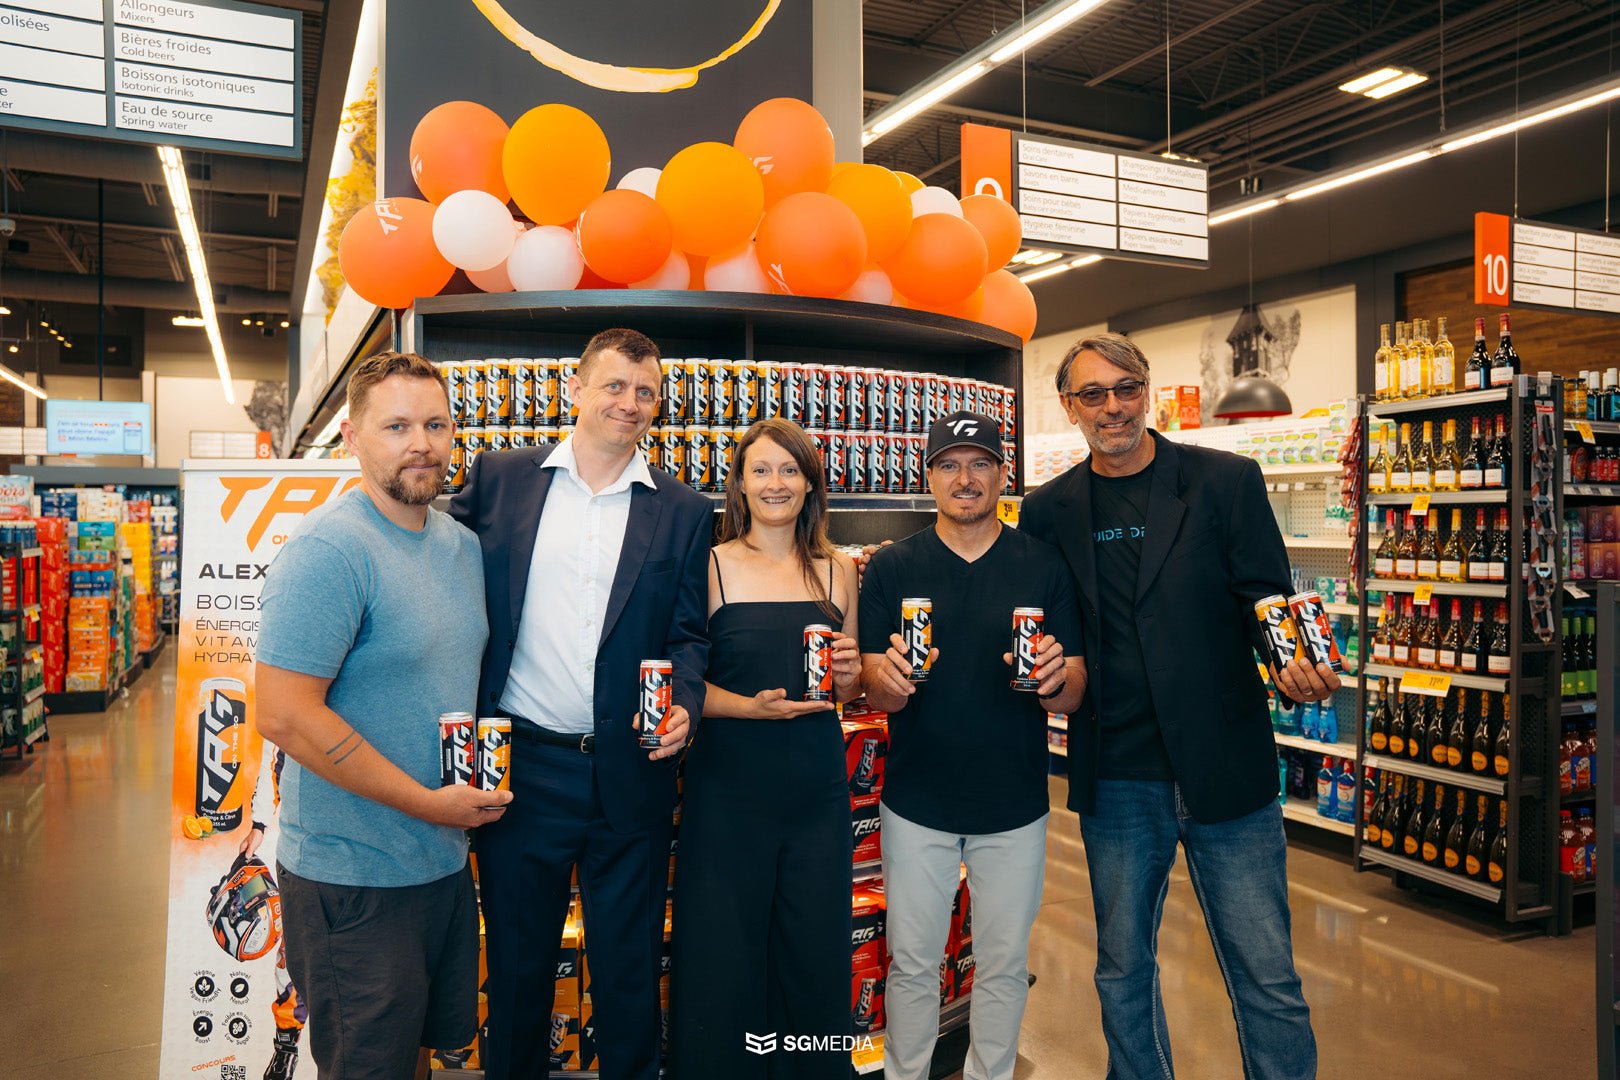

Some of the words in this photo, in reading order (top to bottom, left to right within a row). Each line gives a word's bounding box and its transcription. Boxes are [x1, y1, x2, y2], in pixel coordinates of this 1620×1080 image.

[120, 0, 195, 19] Allongeurs
[120, 11, 155, 24] Mixers
[121, 32, 162, 48] Bières
[166, 38, 212, 55] froides
[121, 46, 145, 58] Cold
[147, 50, 176, 62] beers
[121, 66, 178, 84] Boissons
[182, 76, 256, 95] isotoniques
[121, 81, 164, 95] Isotonic
[167, 86, 194, 98] drinks
[122, 101, 146, 115] Eau
[151, 105, 168, 118] de
[172, 110, 213, 123] source
[122, 115, 155, 129] Spring
[158, 121, 188, 131] water
[1022, 143, 1041, 153] Soins
[1023, 168, 1048, 180] Savons
[1023, 194, 1042, 203] Soins
[1043, 198, 1060, 207] pour
[1483, 254, 1509, 296] 10
[259, 443, 270, 458] 8
[198, 563, 270, 580] ALEX
[194, 652, 256, 664] HYDRA
[191, 1055, 237, 1072] CONCOURS
